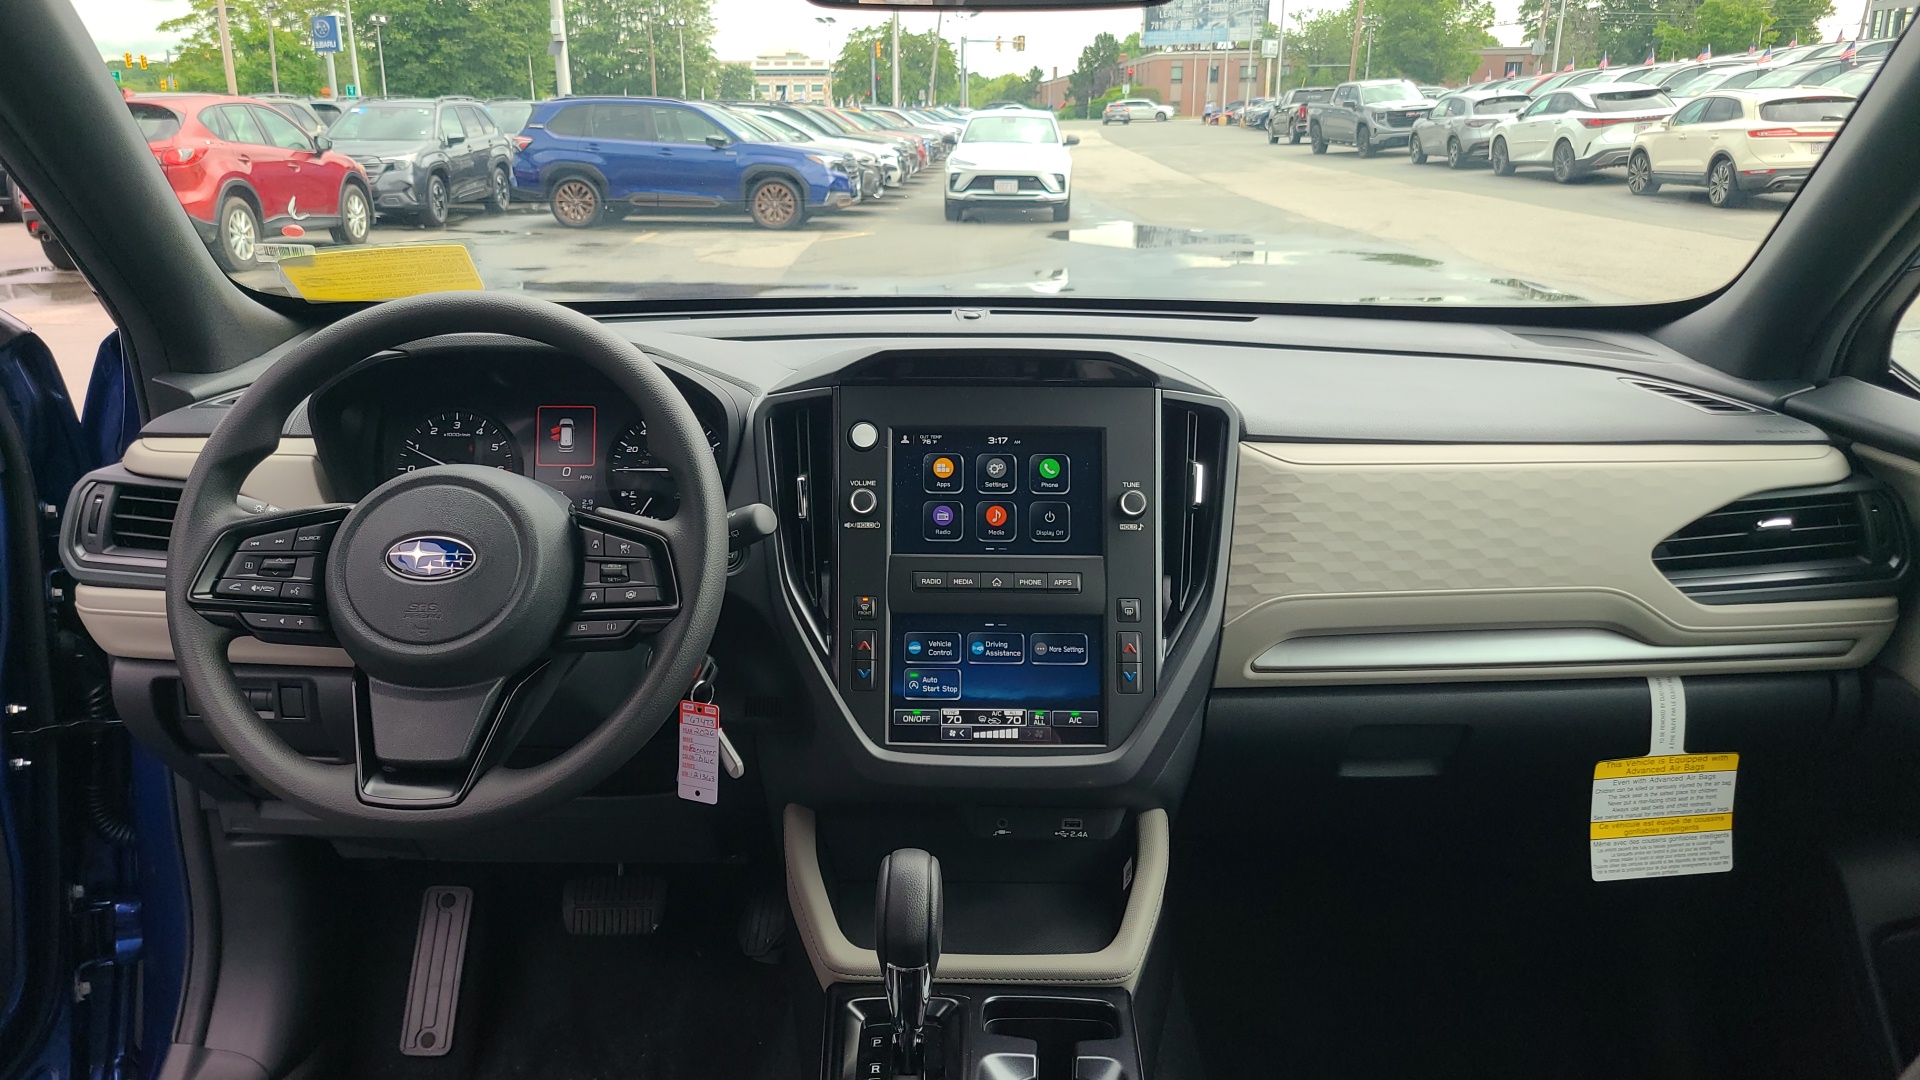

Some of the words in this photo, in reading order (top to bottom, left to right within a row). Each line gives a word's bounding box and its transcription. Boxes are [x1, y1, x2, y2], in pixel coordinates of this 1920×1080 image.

[562, 466, 572, 477] 0
[985, 481, 1008, 489] Settings
[986, 641, 1008, 649] Driving
[1063, 646, 1084, 654] Settings
[942, 685, 958, 694] Stop
[946, 716, 962, 724] 70
[1006, 716, 1021, 724] 70
[1669, 756, 1708, 765] Equipped
[1626, 767, 1665, 775] Advanced
[1650, 775, 1683, 783] Advanced
[1624, 828, 1659, 836] gonflables
[1669, 835, 1697, 843] gonflables
[873, 1038, 881, 1047] P
[871, 1065, 880, 1074] R
